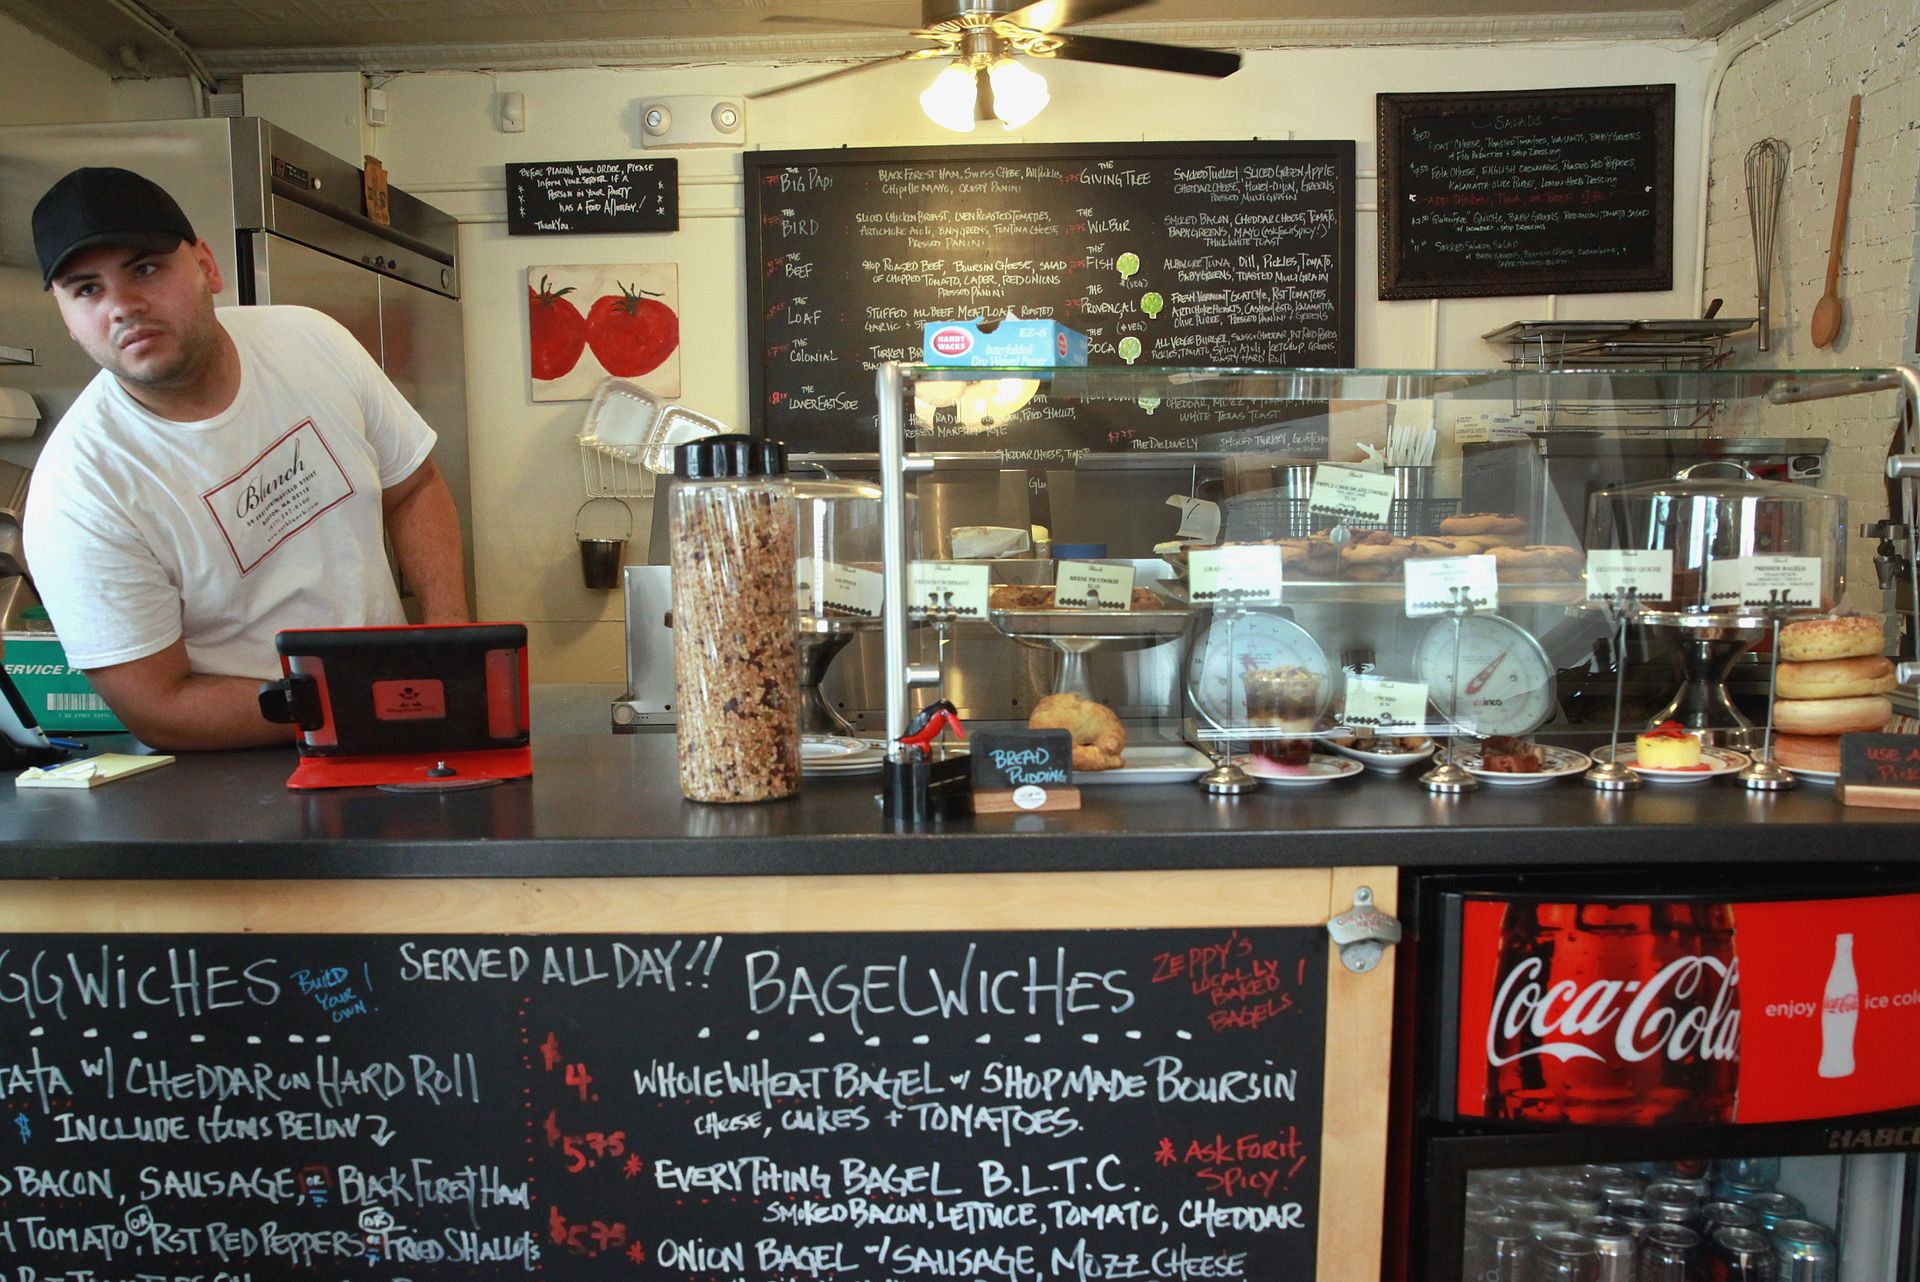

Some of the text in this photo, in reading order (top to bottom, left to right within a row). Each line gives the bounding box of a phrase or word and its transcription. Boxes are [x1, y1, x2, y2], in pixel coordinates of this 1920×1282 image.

[1098, 161, 1114, 170] THE
[622, 174, 629, 183] A
[780, 173, 805, 192] BIG
[1080, 168, 1151, 188] GIVING TREE
[577, 203, 583, 212] A
[781, 209, 795, 217] THE
[1076, 207, 1093, 217] THE
[1087, 218, 1130, 234] WILBUR
[1234, 213, 1274, 225] CHEDDAR
[781, 219, 819, 238] BIRD
[1086, 243, 1105, 254] THE
[1203, 237, 1283, 247] THICK WHITE TOAST
[786, 253, 800, 261] THE
[1086, 256, 1113, 271] FISH
[785, 263, 813, 278] BEEF
[873, 274, 884, 283] OF
[886, 275, 921, 285] CHOPPED
[1002, 274, 1025, 286] RED
[1025, 273, 1061, 285] ONIONS
[1086, 284, 1103, 295] THE
[793, 297, 808, 305] THE
[1171, 292, 1196, 304] FRESH
[787, 306, 823, 325] LOAF
[866, 306, 907, 319] STUFFED
[930, 306, 954, 318] BEEF
[938, 335, 965, 343] HANDY
[1019, 328, 1047, 338] EZ-6
[1087, 328, 1103, 336] THE
[792, 338, 808, 347] THE
[938, 343, 966, 351] WACKS
[870, 346, 906, 361] TURKEY
[801, 385, 815, 393] THE
[789, 398, 819, 411] LOWER
[836, 391, 859, 410] SIDE
[1131, 440, 1149, 449] THE
[237, 438, 306, 519] Blunch
[989, 747, 1050, 769] BREAD
[1152, 930, 1254, 983] ZEPPY'S
[400, 942, 530, 983] SERVED
[542, 945, 609, 987] ALL
[1210, 976, 1280, 1006] BAKED
[1487, 955, 1741, 1067] Coca-Cola
[1765, 1000, 1817, 1019] enjoy
[1865, 993, 1889, 1009] ice
[126, 1057, 282, 1101] CHEDDAR
[317, 1055, 406, 1108] HARD
[723, 1058, 829, 1109] WHEAT
[832, 1061, 945, 1109] BAGEL
[54, 1113, 190, 1142] INCLUDE
[276, 1111, 360, 1142] BELOW
[781, 1107, 871, 1135] CUKES
[654, 1154, 1142, 1202] EVERYTHING BAGEL B.L.T.C.
[14, 1157, 531, 1230] BACON, SAUSAGE, BLACK FOREST HAM
[763, 1201, 849, 1227] SMOKED
[1178, 1197, 1306, 1238] CHEDDAR
[206, 1221, 259, 1262] RED
[259, 1221, 366, 1267] PEPPERS
[755, 1237, 858, 1273] BAGEL
[1051, 1237, 1149, 1282] MOZZ
[1151, 1242, 1247, 1282] CHEESE
